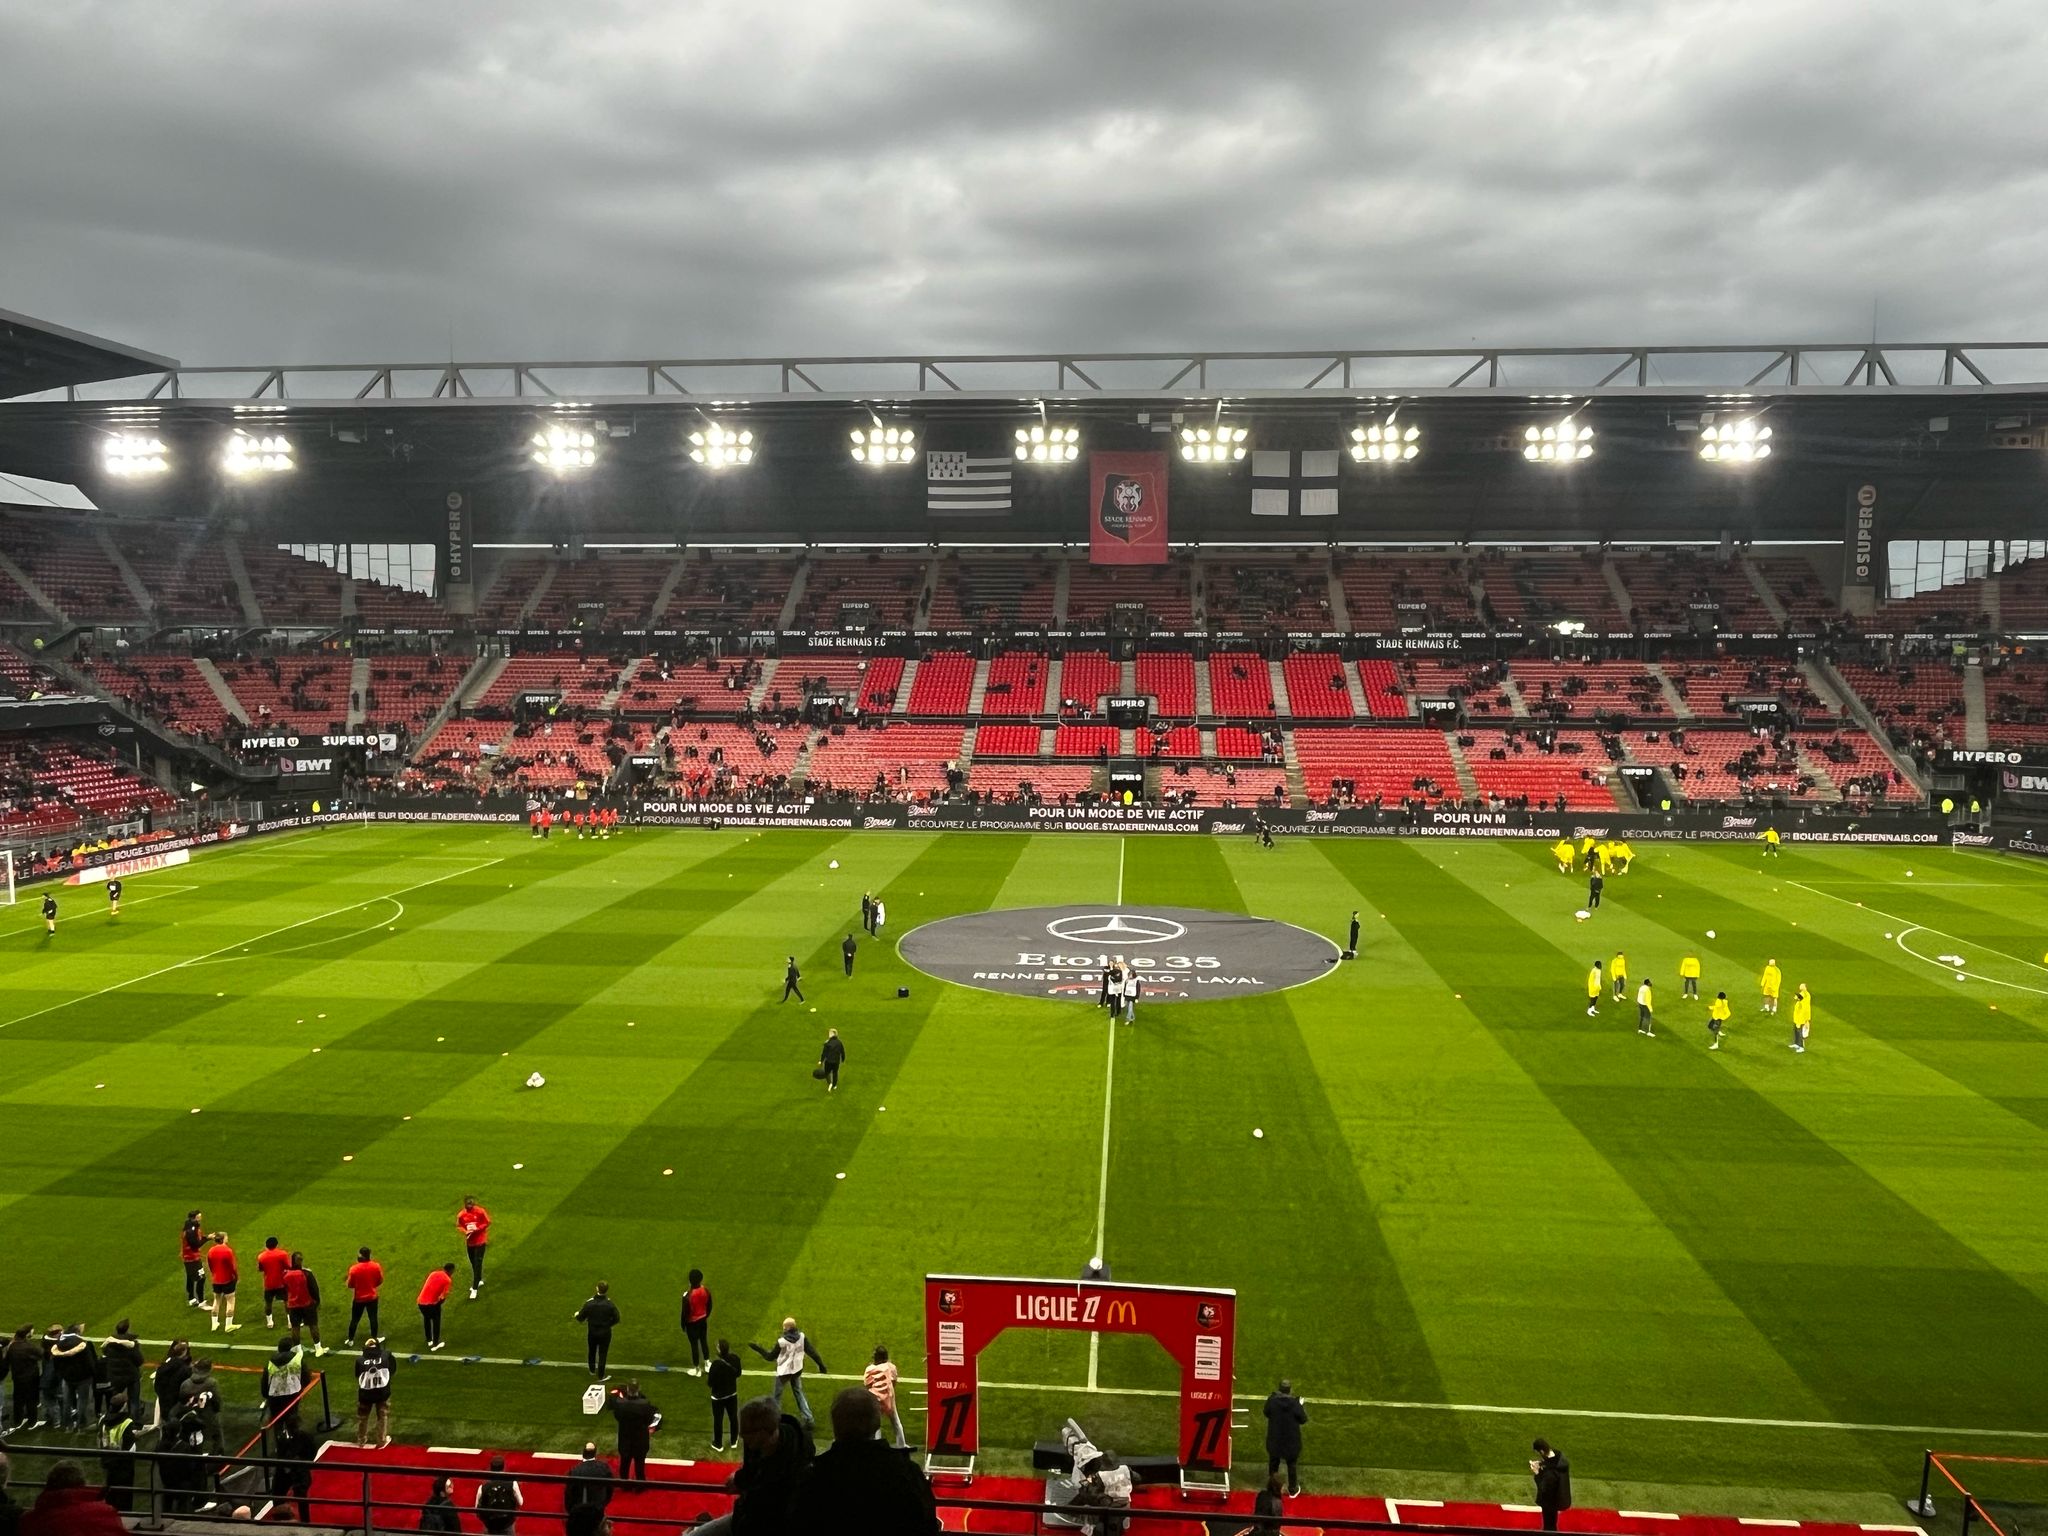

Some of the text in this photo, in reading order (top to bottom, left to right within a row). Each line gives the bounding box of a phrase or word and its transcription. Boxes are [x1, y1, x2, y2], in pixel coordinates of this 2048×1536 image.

[1857, 507, 1873, 563] SUPER
[808, 638, 833, 647] STADE
[836, 638, 872, 647] RENNAIS
[1376, 640, 1403, 648] STADE
[1405, 640, 1444, 648] RENNAIS
[1110, 700, 1137, 708] SUPER
[242, 737, 285, 748] HYPER
[322, 735, 364, 746] SUPER
[1952, 751, 2006, 763] HYPER
[644, 804, 810, 814] POUR UN MODE DE VIE ACTIF
[1030, 808, 1204, 820] POUR UN MODE DE VIE ACTIF
[301, 816, 311, 824] LE
[312, 810, 376, 823] PROGRAMME
[378, 812, 396, 820] SUR
[643, 816, 700, 824] PROGRAMME
[724, 818, 851, 827] BOUGE.STADERENNAIS.COM
[1433, 813, 1470, 824] POUR
[1473, 814, 1493, 824] UN
[966, 820, 978, 829] LE
[980, 821, 1041, 830] PROGRAMME
[1044, 822, 1064, 830] SUR
[1066, 822, 1198, 832] BOUGE.STADERENNAIS.COM
[1270, 825, 1560, 838] COUVREZ LE PROGRAMME SUR BOUGE.STADERENNAIS.COM
[1685, 831, 1697, 840] LE
[1792, 832, 1938, 843] BOUGE.STADERENNAIS.COM
[105, 853, 168, 878] WINAMAX
[1165, 956, 1221, 968] 35
[973, 972, 1060, 981] RENNES
[1196, 976, 1264, 984] LAVAL
[1016, 1294, 1078, 1322] LIGUE
